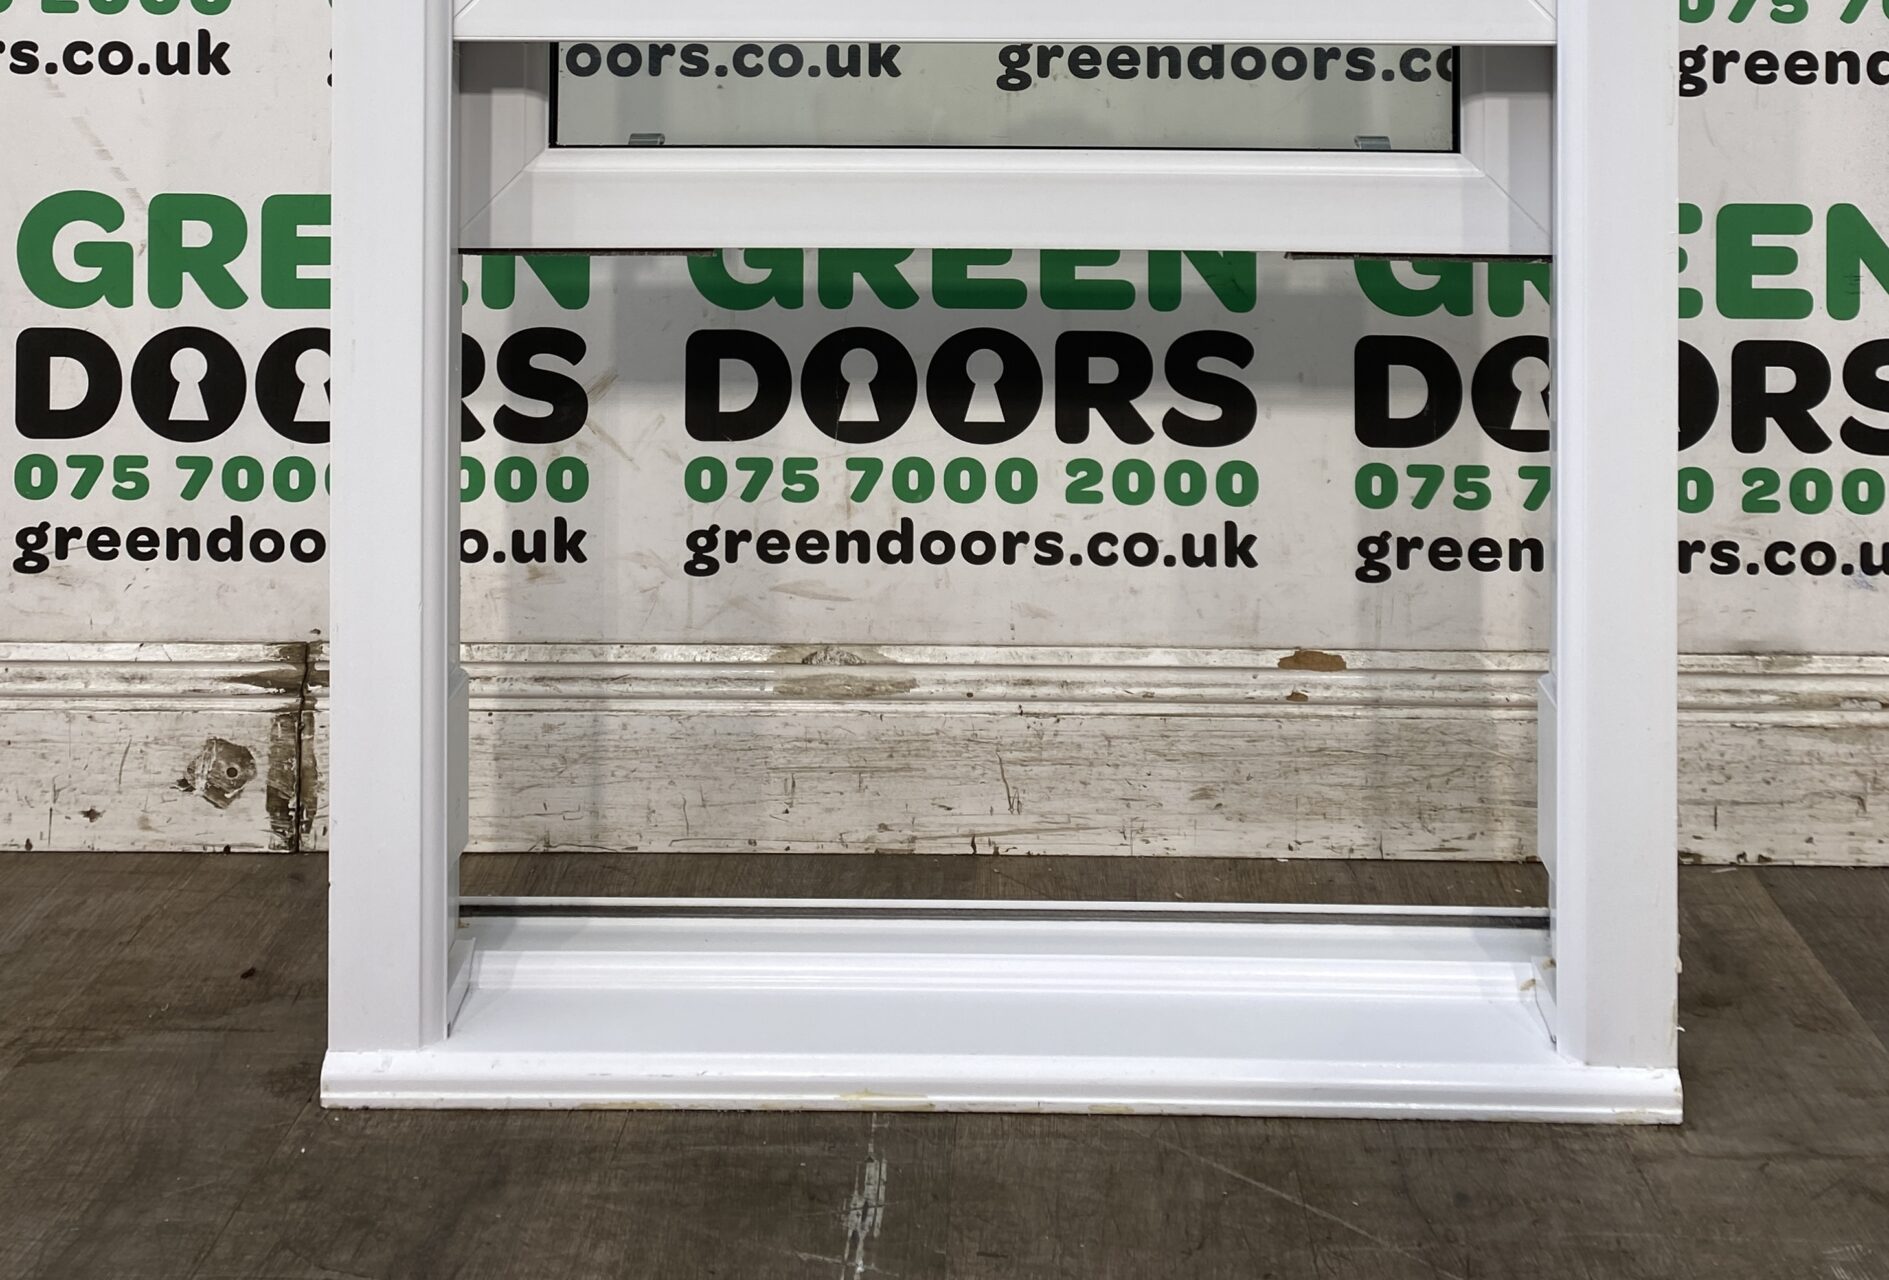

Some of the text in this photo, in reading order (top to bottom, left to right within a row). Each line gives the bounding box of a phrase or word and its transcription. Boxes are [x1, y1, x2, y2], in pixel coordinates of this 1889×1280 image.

[0, 29, 231, 76] s.co.uk
[565, 42, 903, 78] oors.co.uk
[685, 326, 1258, 448] DOORS
[13, 453, 331, 503] 075 700
[684, 456, 1260, 507] 075 7000 2000
[1354, 462, 1492, 512] 075
[683, 516, 1259, 578] greendoors.co.uk
